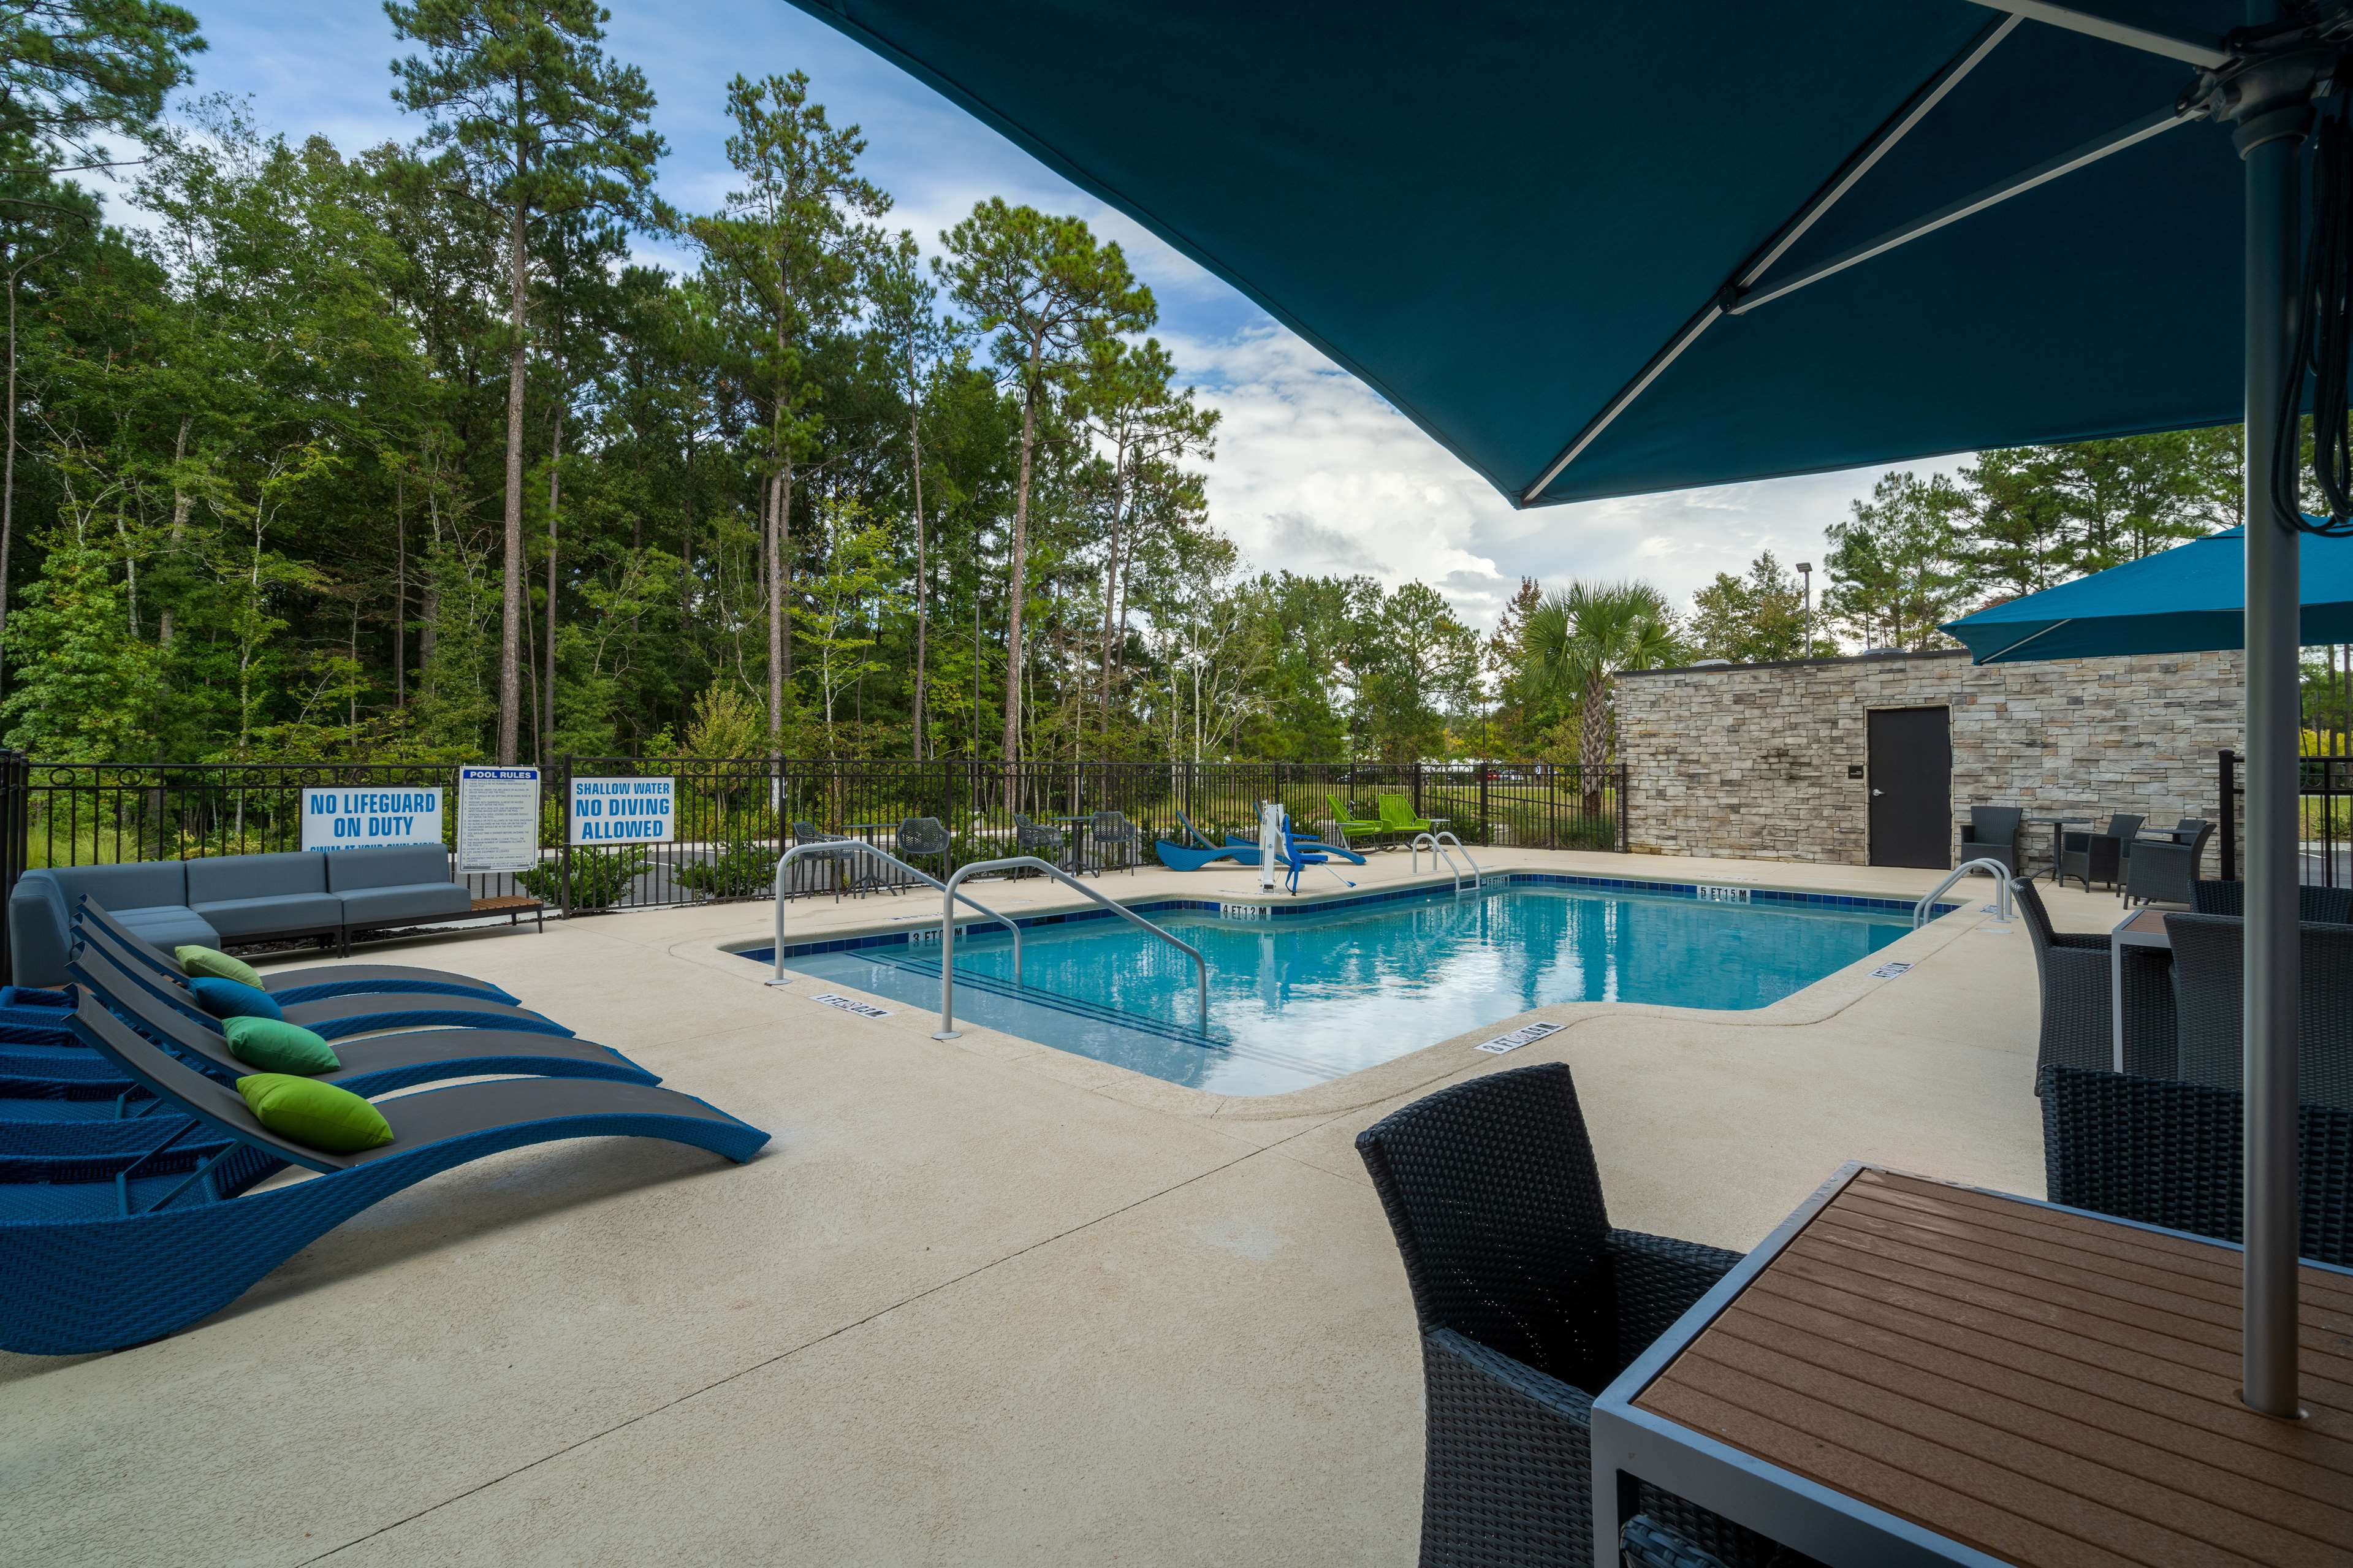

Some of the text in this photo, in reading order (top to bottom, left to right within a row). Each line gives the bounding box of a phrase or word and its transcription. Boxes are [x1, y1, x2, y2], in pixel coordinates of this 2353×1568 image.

[576, 783, 669, 795] SHALLOW WATER
[311, 793, 435, 815] NO LIFEGUARD
[576, 798, 669, 816] NO DIVING
[333, 816, 414, 837] ON DUTY
[581, 820, 663, 840] ALLOWED
[1223, 904, 1228, 913] 4
[913, 932, 919, 942] 3
[954, 927, 962, 937] M
